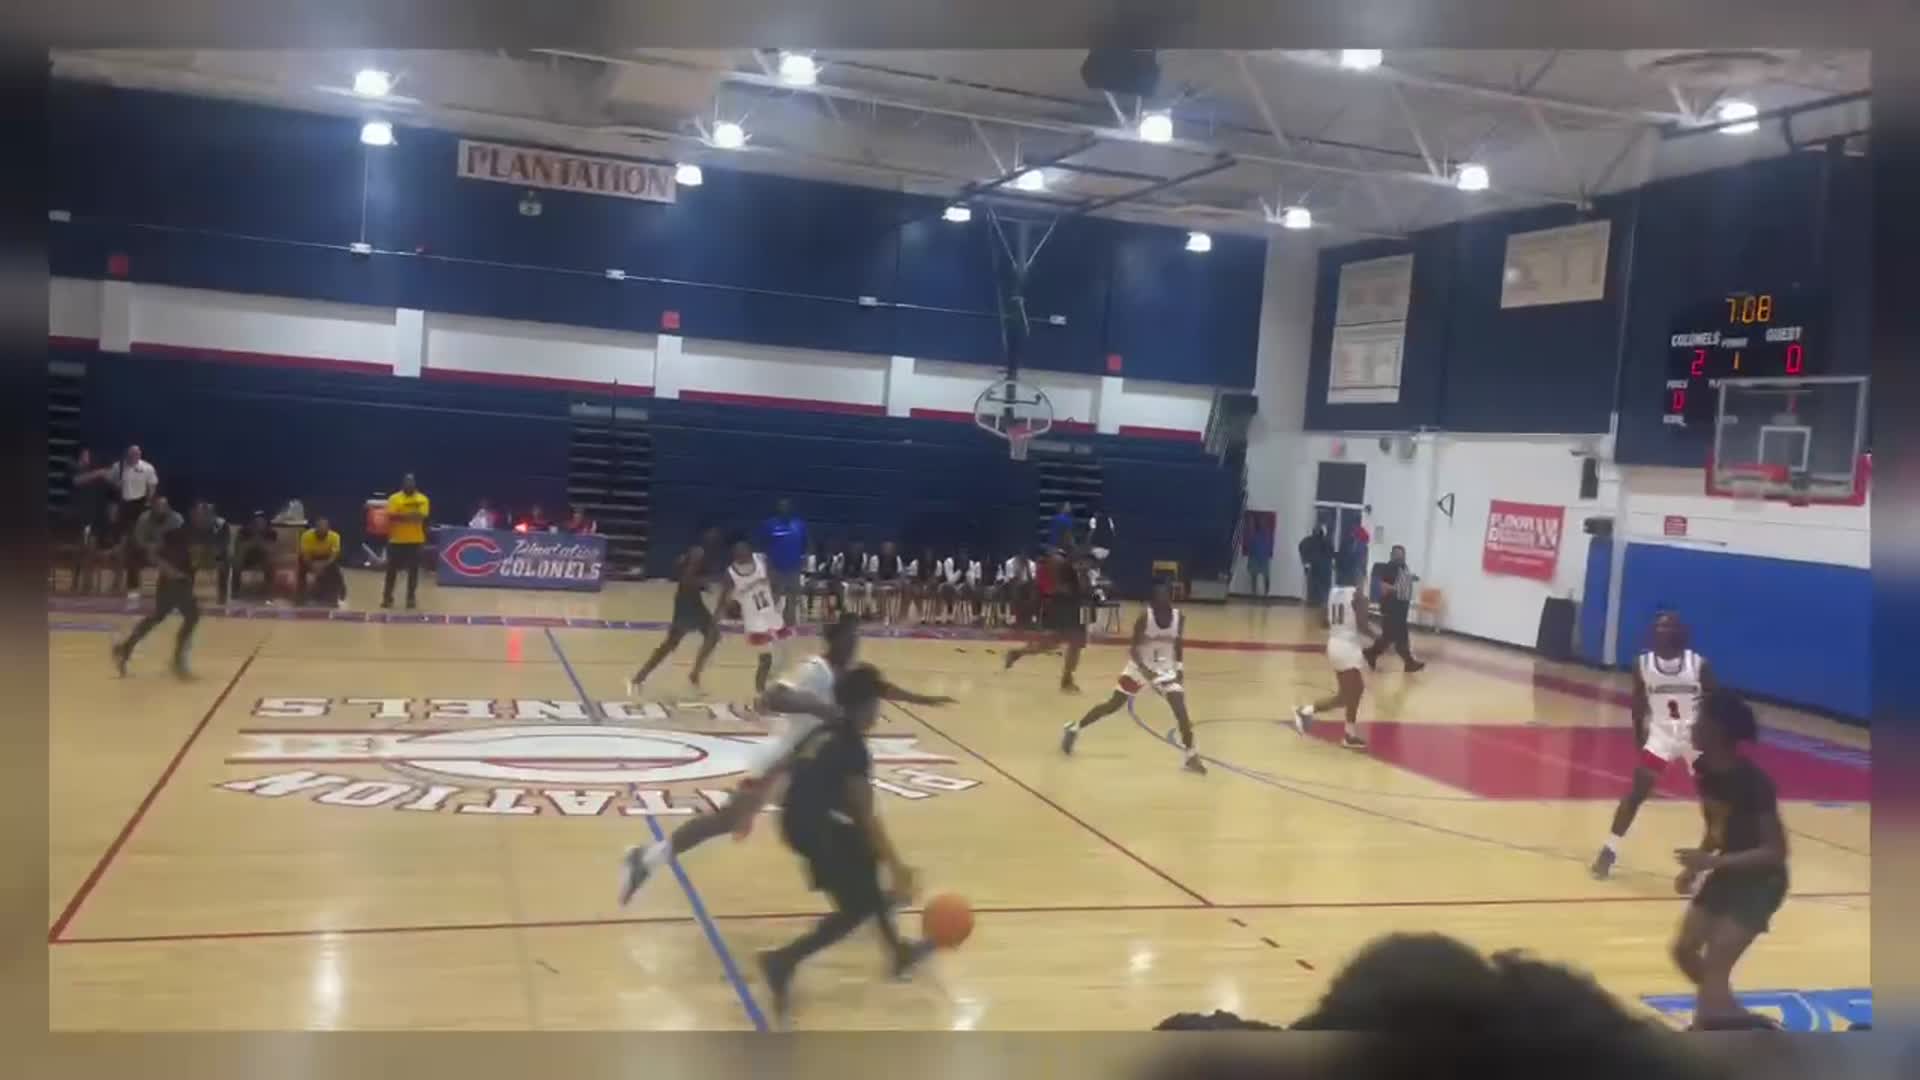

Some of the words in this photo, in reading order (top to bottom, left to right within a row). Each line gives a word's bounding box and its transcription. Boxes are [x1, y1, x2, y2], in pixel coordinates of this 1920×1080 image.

[467, 145, 669, 197] PLANTATION
[1765, 327, 1802, 342] GUEST
[1691, 349, 1705, 375] 2
[1786, 344, 1802, 373] 0
[500, 559, 602, 580] COLONELS
